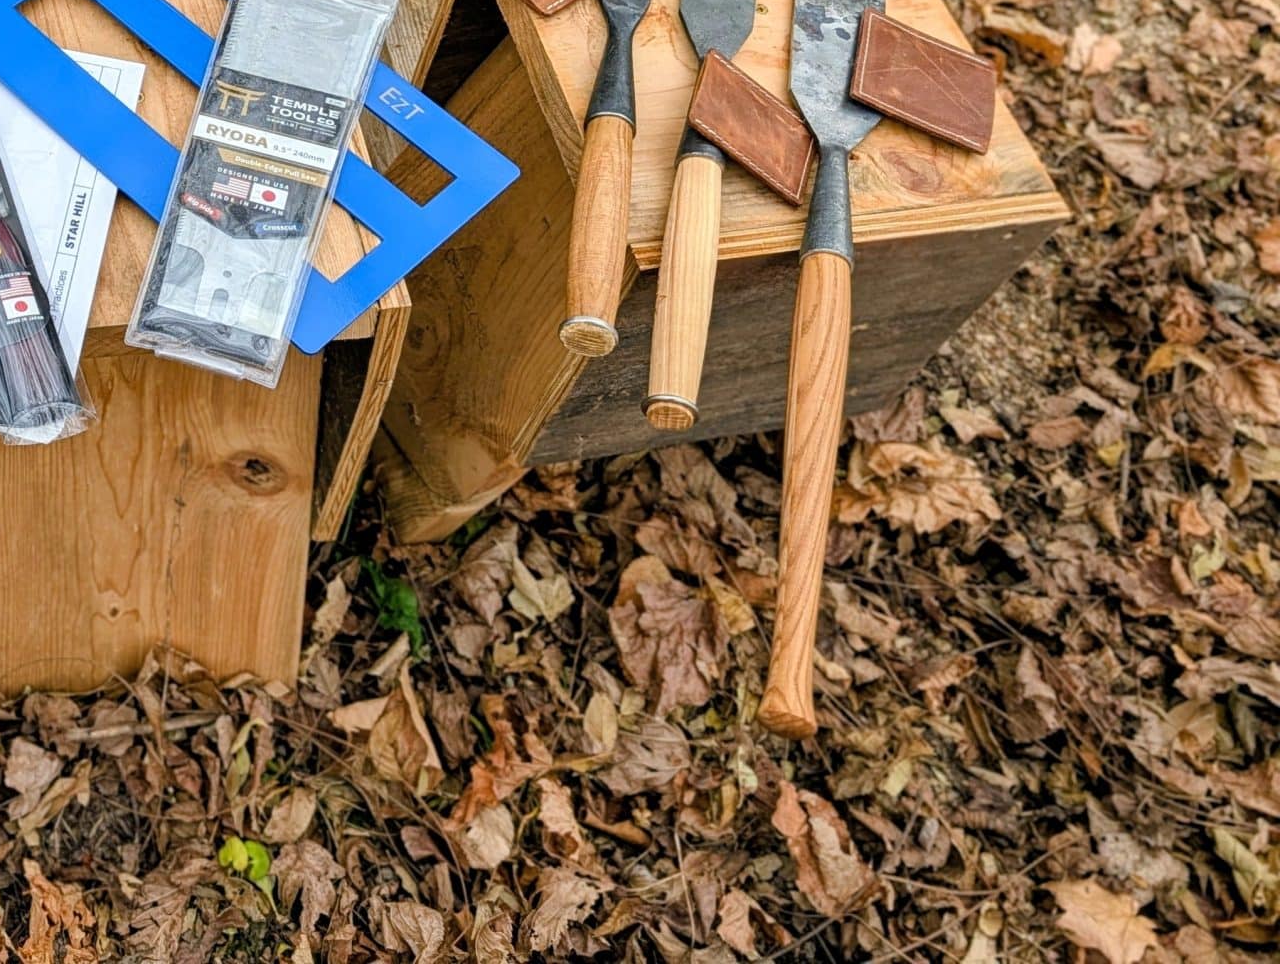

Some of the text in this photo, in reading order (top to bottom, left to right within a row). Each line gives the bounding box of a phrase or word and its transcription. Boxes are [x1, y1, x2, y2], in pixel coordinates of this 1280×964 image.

[270, 104, 316, 124] TOOL
[271, 94, 341, 120] TEMPLE
[379, 87, 425, 120] EzT
[206, 123, 269, 149] RYOBA
[293, 149, 325, 164] 240mm
[217, 166, 289, 190] DESIGNED IN USA
[210, 192, 284, 217] MADE IN JAPAN
[262, 223, 298, 232] Crosscut
[51, 192, 87, 313] Practices STAR HILL
